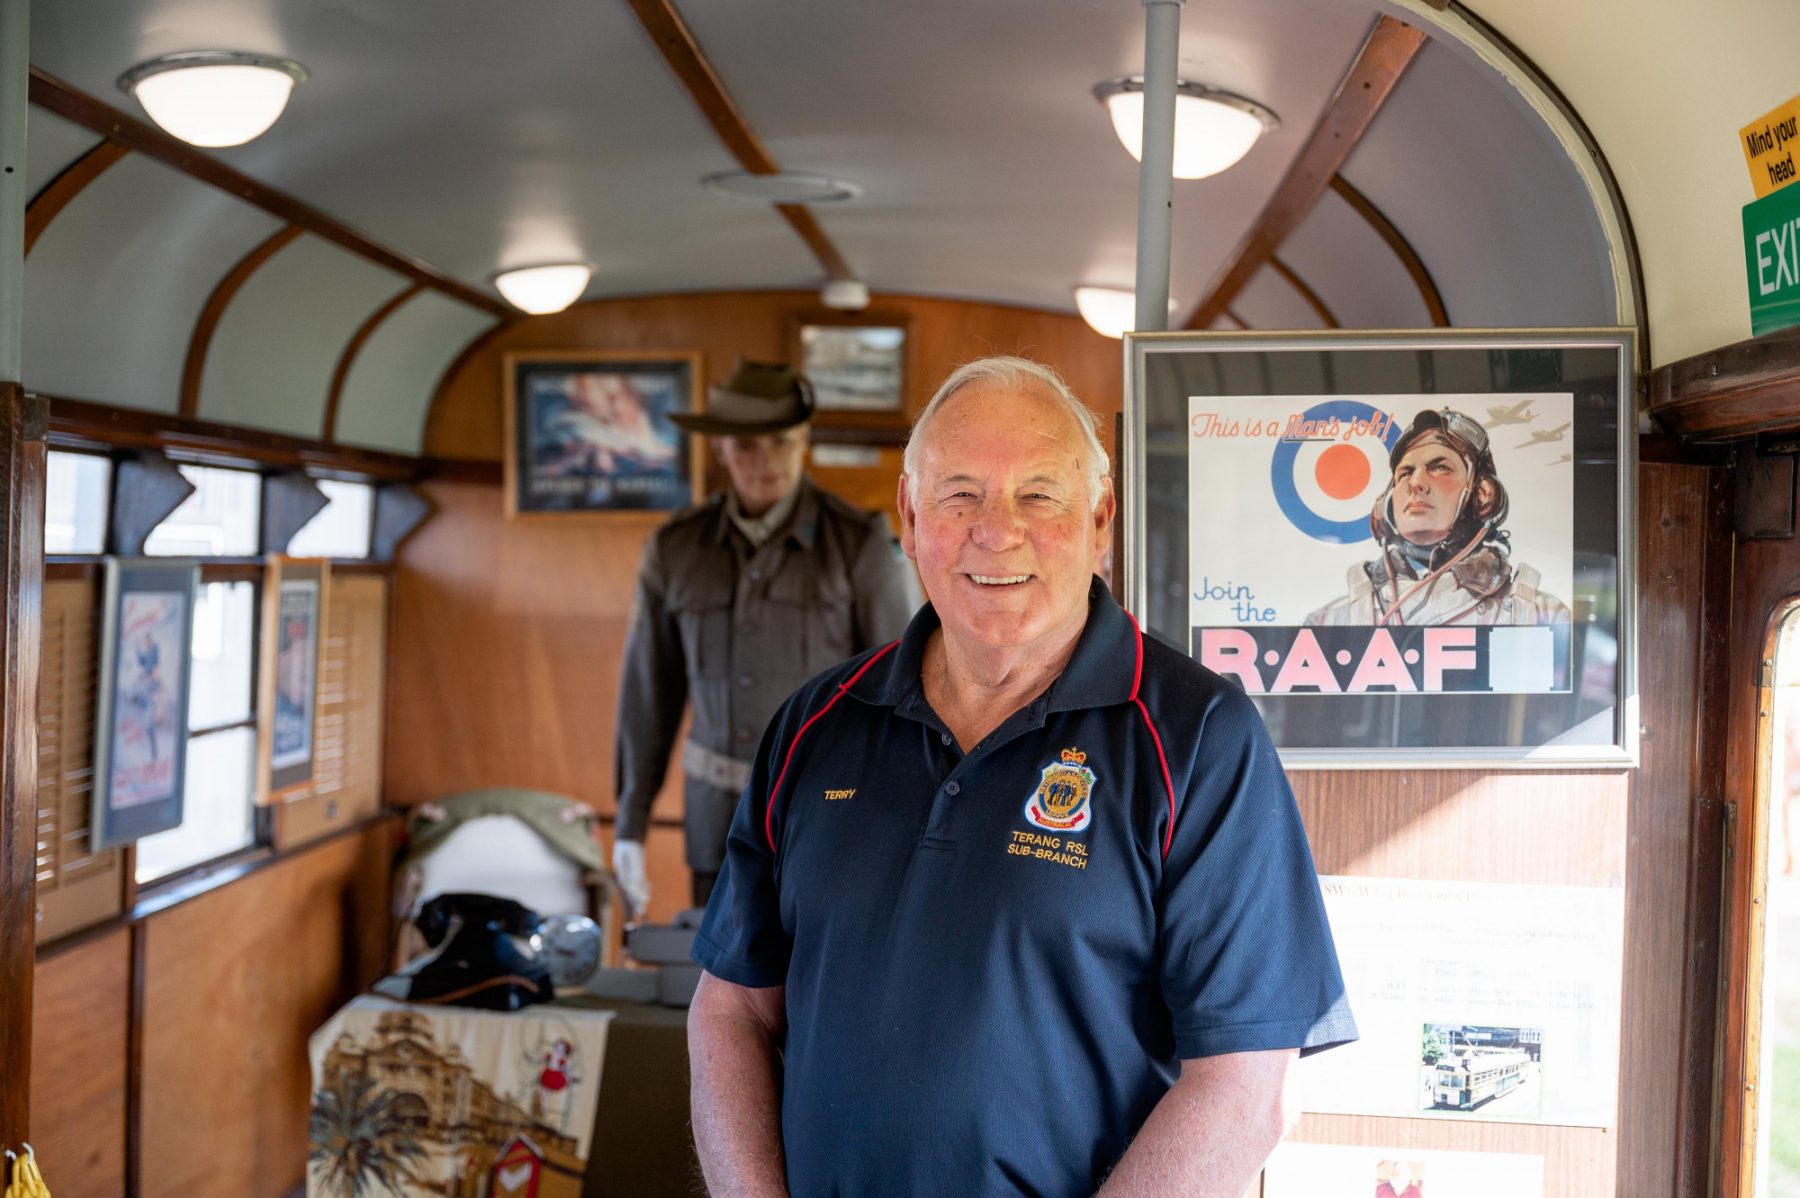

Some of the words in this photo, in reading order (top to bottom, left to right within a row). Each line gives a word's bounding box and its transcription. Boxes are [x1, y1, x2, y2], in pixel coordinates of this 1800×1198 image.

[1746, 124, 1774, 159] Mind
[1773, 116, 1798, 152] your
[1767, 151, 1796, 186] head
[1191, 413, 1240, 438] This
[1244, 418, 1262, 438] is
[1266, 420, 1280, 437] a
[1283, 412, 1341, 438] Man's
[1343, 410, 1394, 442] job!
[1193, 576, 1255, 600] Join
[1230, 601, 1276, 622] the
[824, 789, 857, 800] TERRY
[1008, 843, 1087, 869] SUB-BRANCH
[1012, 831, 1061, 849] TERANG
[1066, 841, 1089, 856] RSL
